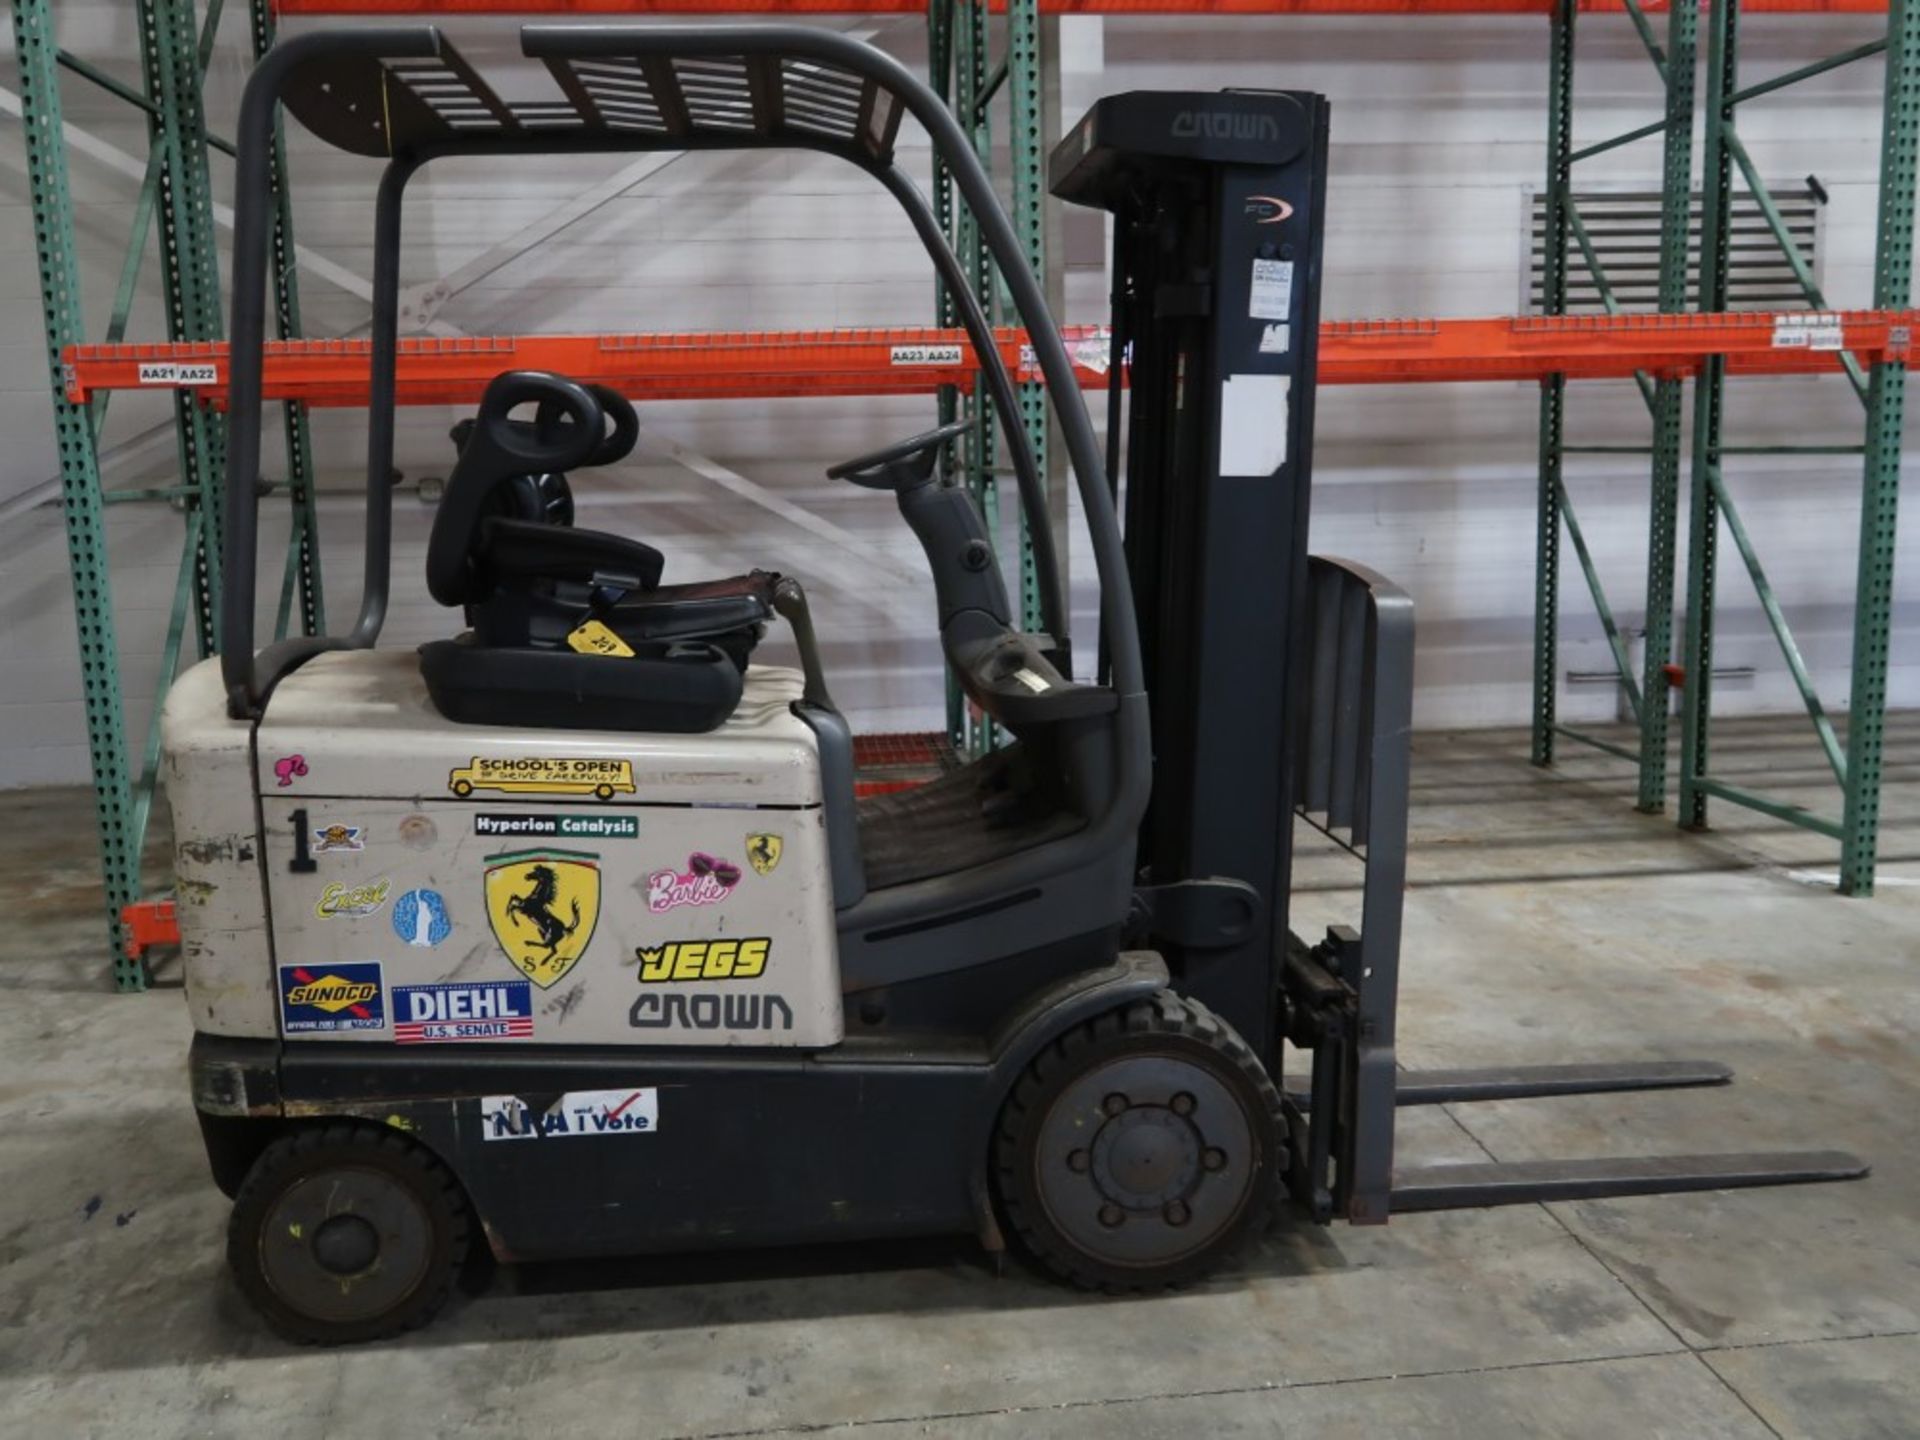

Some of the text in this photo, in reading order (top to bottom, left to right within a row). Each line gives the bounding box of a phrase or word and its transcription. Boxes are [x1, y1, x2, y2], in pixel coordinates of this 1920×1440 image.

[1171, 110, 1279, 140] CROWN
[892, 350, 960, 361] AA23 AA24
[142, 368, 214, 380] AA21 AA22
[480, 759, 622, 773] SCHOOL'S OPEN
[477, 817, 635, 835] Hyperion Catalysis
[287, 808, 317, 873] 1
[316, 879, 390, 919] Excel
[651, 872, 727, 909] Barbie
[637, 937, 772, 982] JEGS
[292, 985, 374, 1003] SUNOCO
[410, 989, 519, 1021] DIEHL
[629, 994, 793, 1029] CROWN
[424, 1022, 508, 1038] U.S. SENATE
[591, 1113, 649, 1131] Vote
